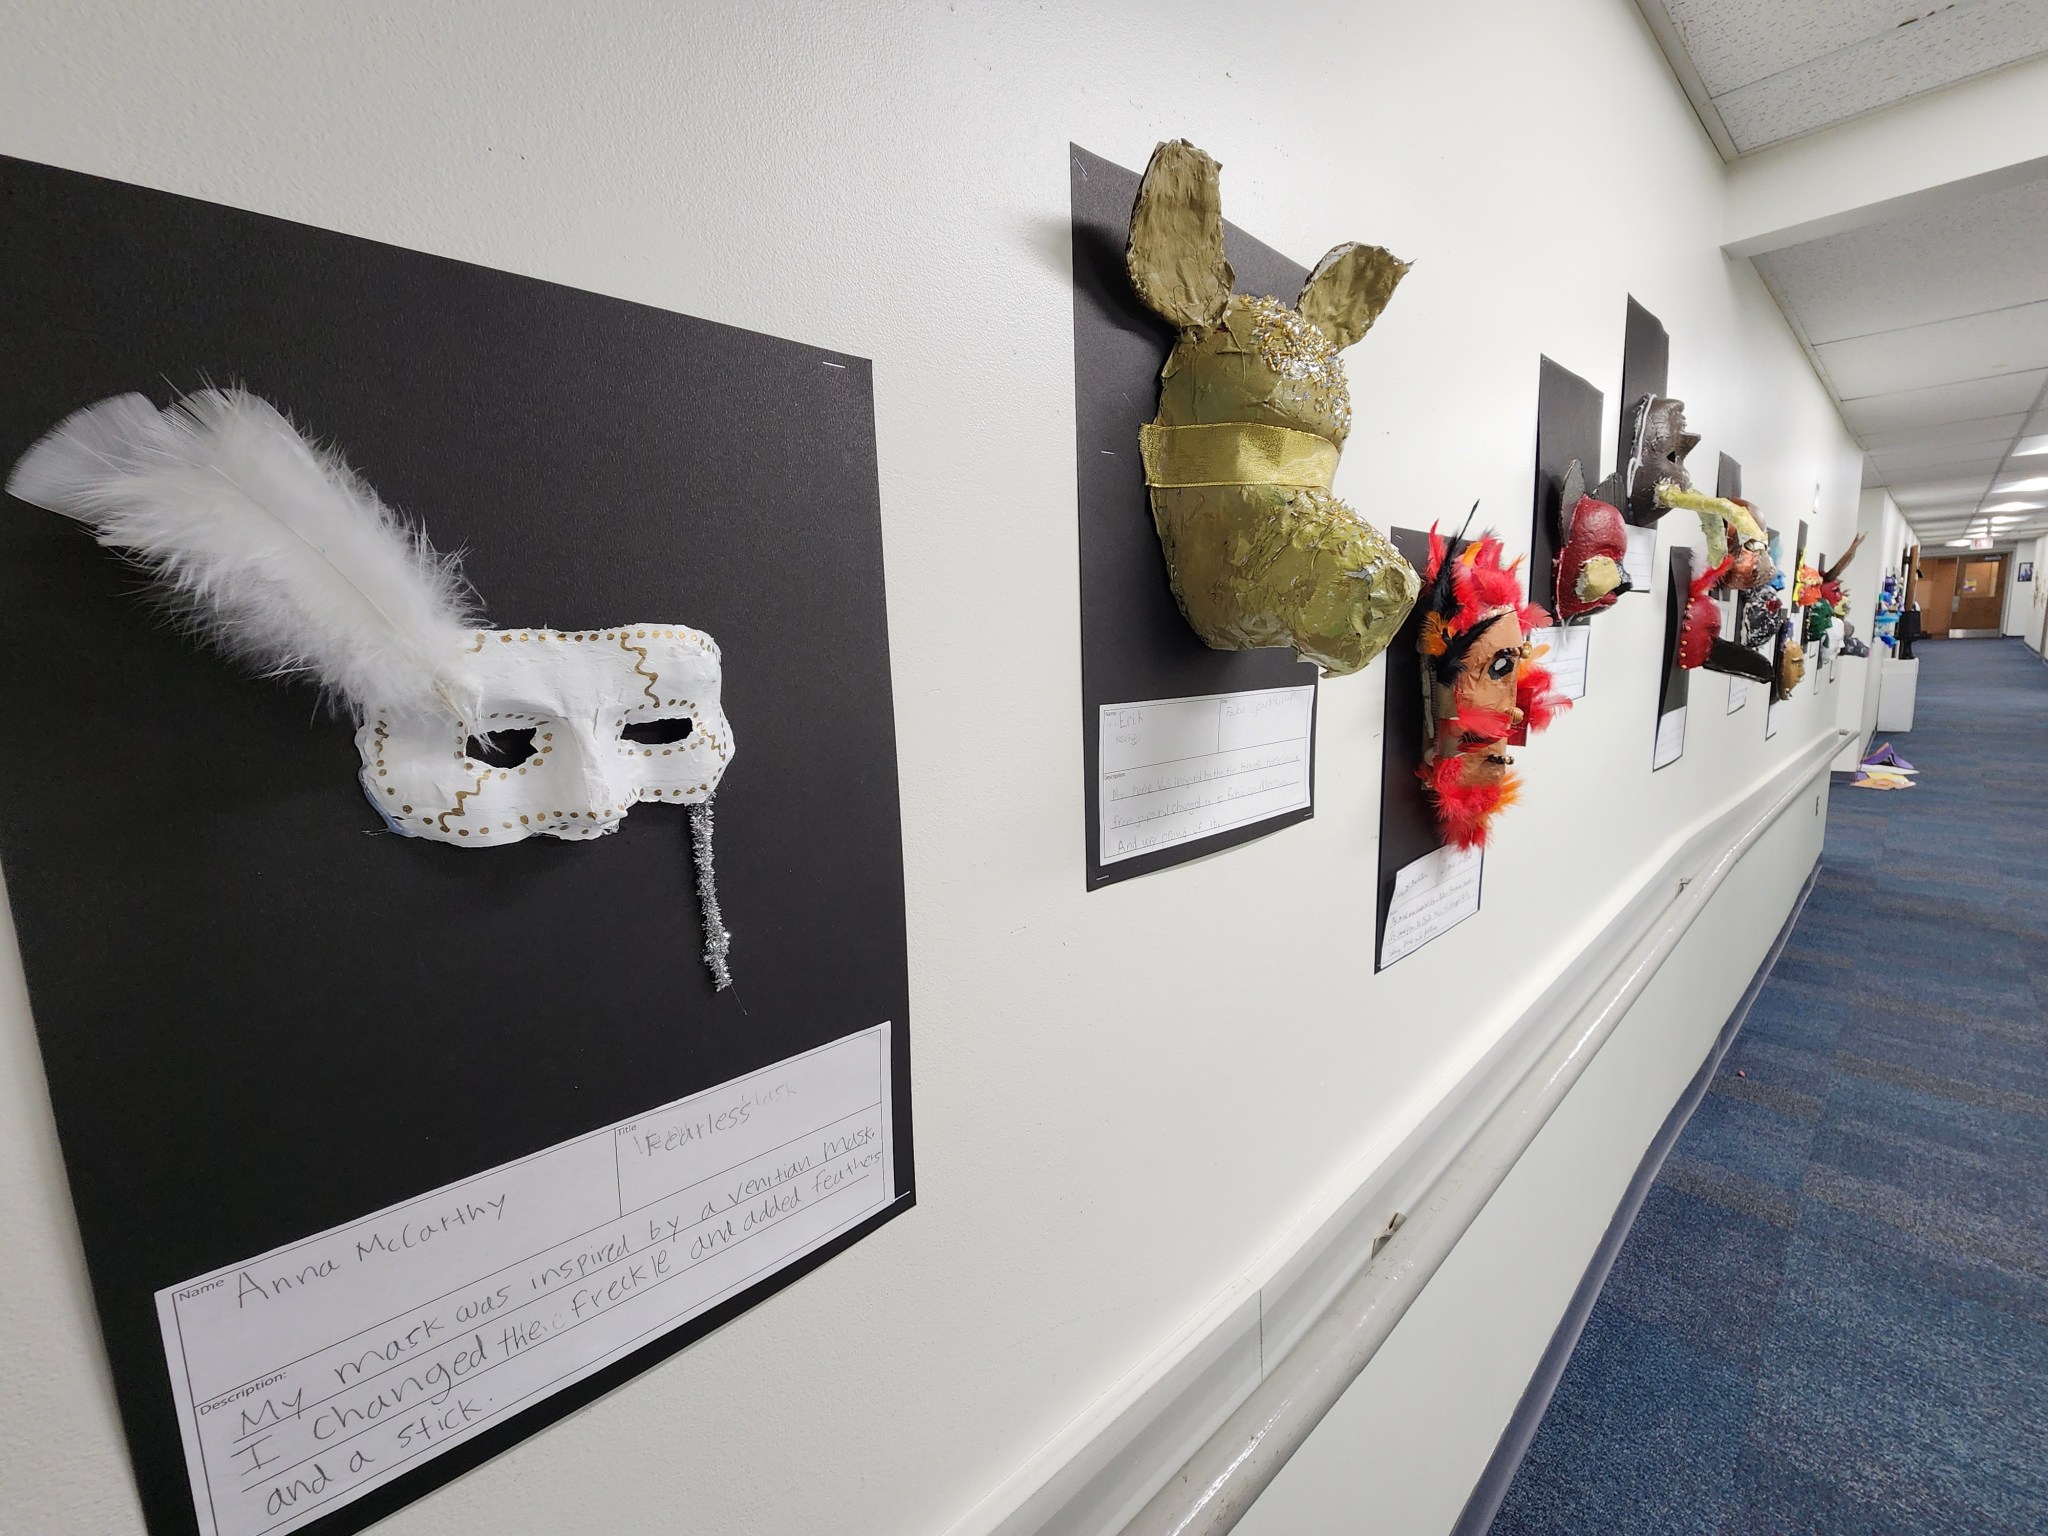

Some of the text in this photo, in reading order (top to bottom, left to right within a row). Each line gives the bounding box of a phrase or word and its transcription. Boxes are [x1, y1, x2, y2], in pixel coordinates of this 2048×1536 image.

[617, 1124, 637, 1135] Title
[236, 1194, 505, 1308] Anna McCarthy
[179, 1279, 225, 1301] Name
[241, 1388, 302, 1436] My
[334, 1319, 445, 1384] mask
[456, 1284, 512, 1323] was
[531, 1234, 630, 1289] inspired
[649, 1216, 679, 1243] by
[701, 1201, 717, 1220] a
[230, 1434, 281, 1477] I
[313, 1334, 487, 1441] changed
[690, 1220, 737, 1260] and
[743, 1186, 801, 1232] added
[199, 1373, 287, 1416] Description:
[267, 1464, 335, 1516] and
[349, 1450, 375, 1473] a
